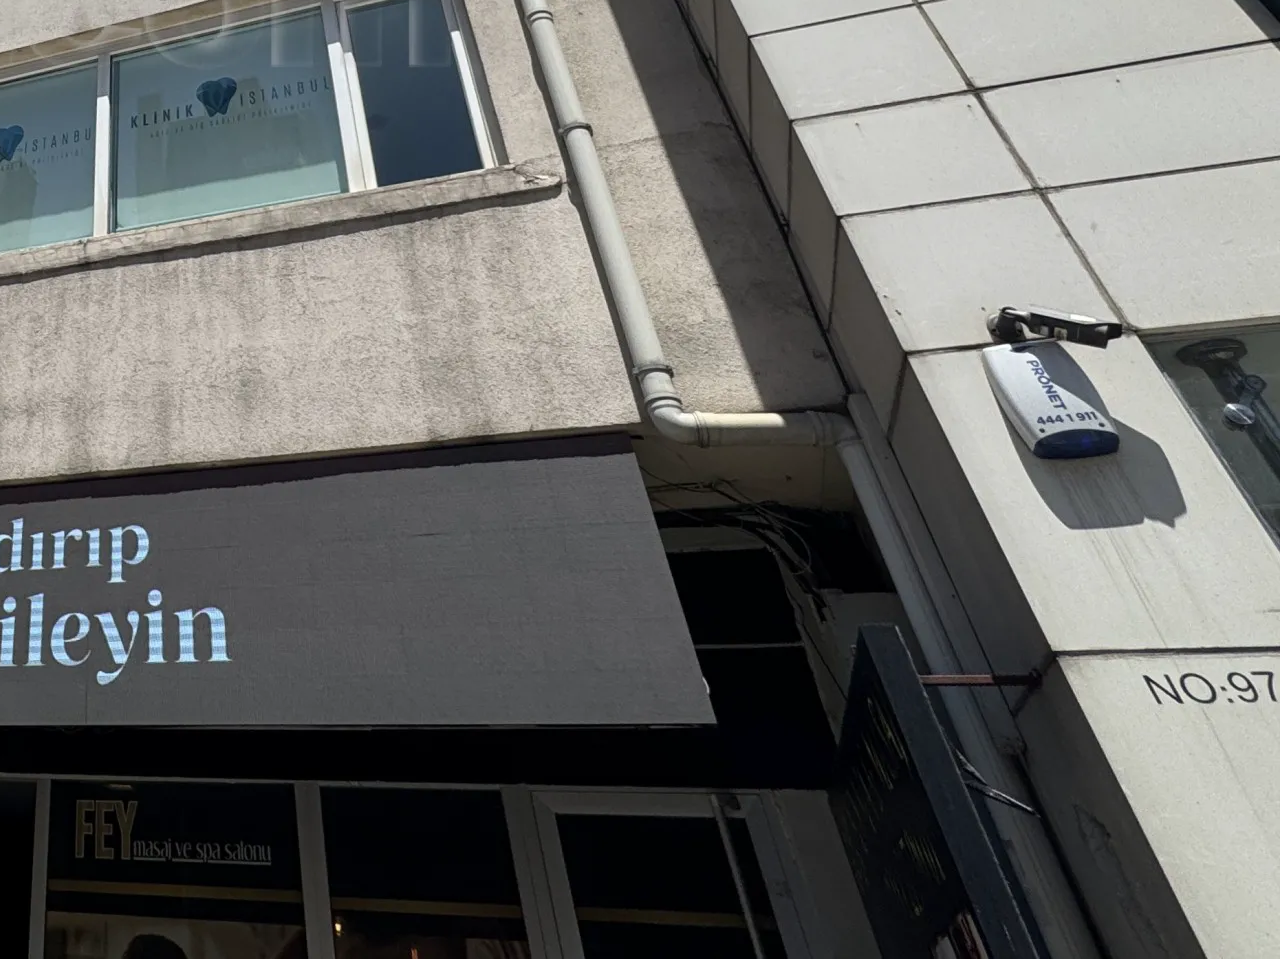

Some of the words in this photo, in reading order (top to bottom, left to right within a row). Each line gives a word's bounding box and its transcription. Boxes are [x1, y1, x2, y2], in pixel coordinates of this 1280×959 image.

[1026, 360, 1067, 410] PRONET
[1037, 414, 1064, 425] 444
[1065, 413, 1074, 422] 1
[1076, 411, 1098, 421] 911
[1142, 671, 1278, 705] NO:97
[74, 799, 139, 860] FEY
[133, 837, 172, 862] masaj
[175, 839, 192, 858] ve
[196, 840, 221, 863] spa
[224, 839, 272, 862] salonu
